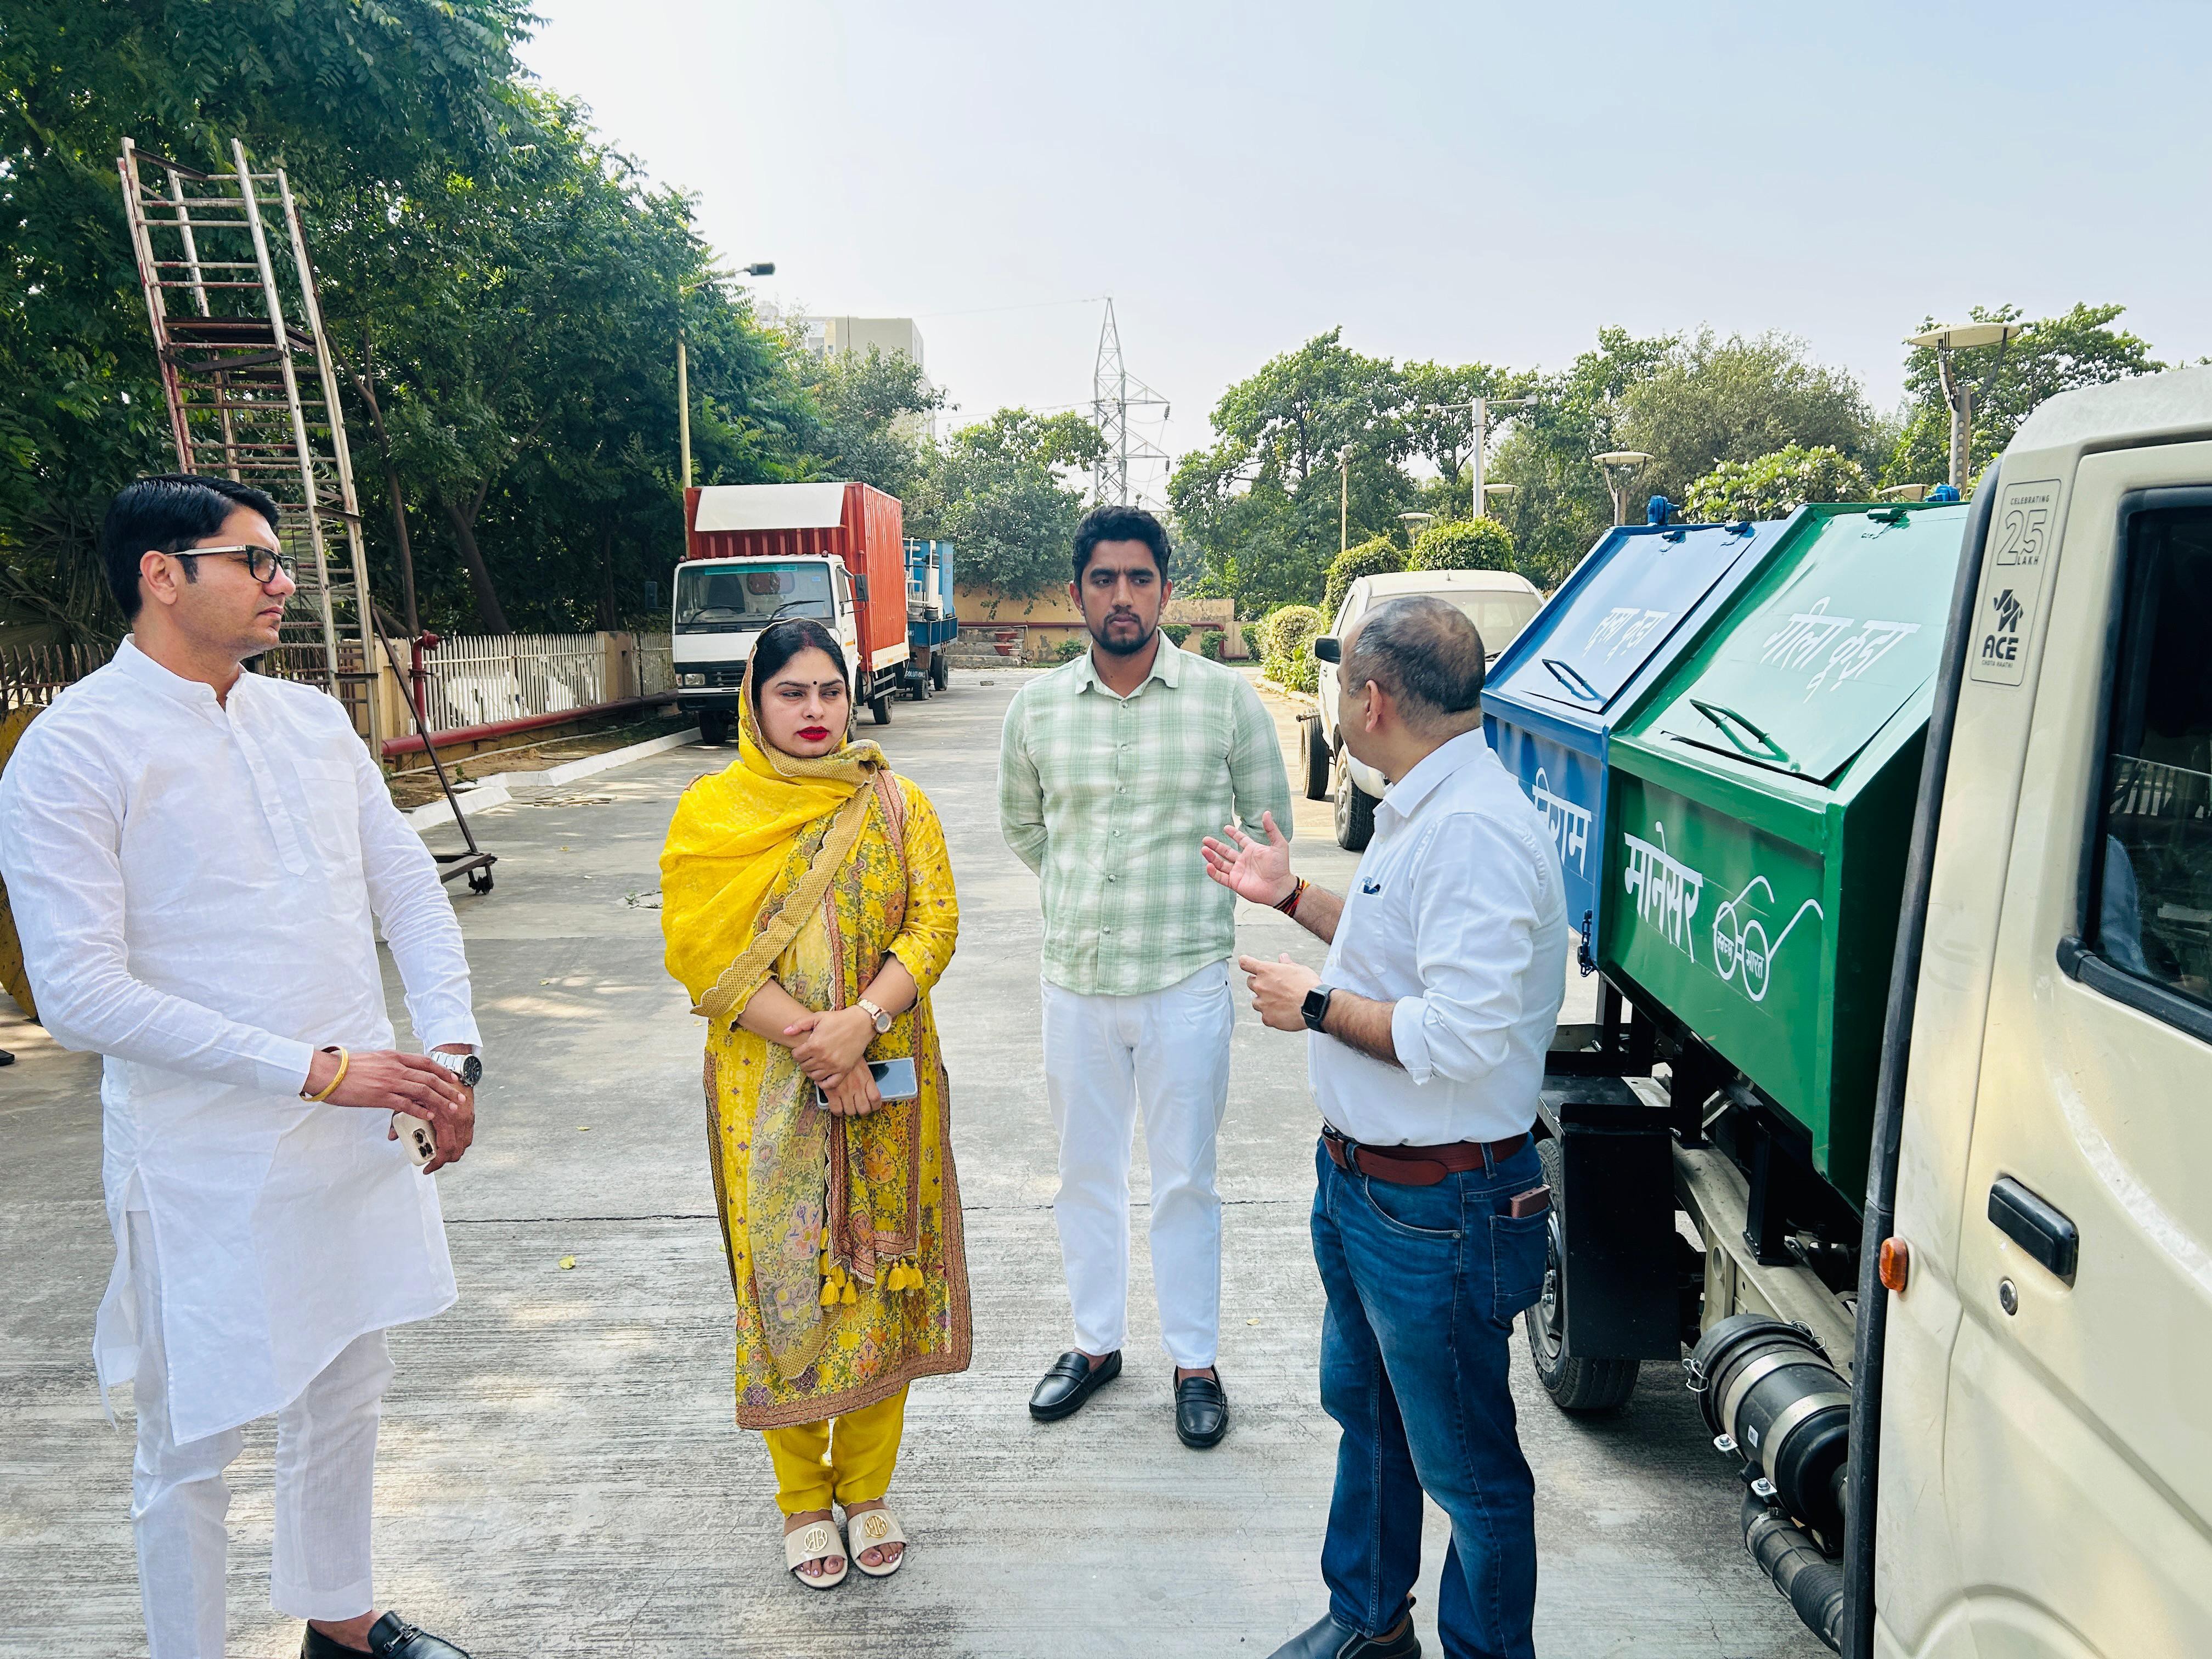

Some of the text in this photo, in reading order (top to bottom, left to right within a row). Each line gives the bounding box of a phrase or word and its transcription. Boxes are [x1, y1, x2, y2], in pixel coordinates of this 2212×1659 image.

[2010, 495, 2050, 505] CELEBRATING
[1997, 509, 2047, 565] 25
[2017, 555, 2040, 566] LAKH
[1759, 596, 1922, 704] गीला कूड़ा
[1982, 634, 2019, 660] ACE
[1624, 821, 1703, 963] मानेसर
[1746, 948, 1765, 979] भारत
